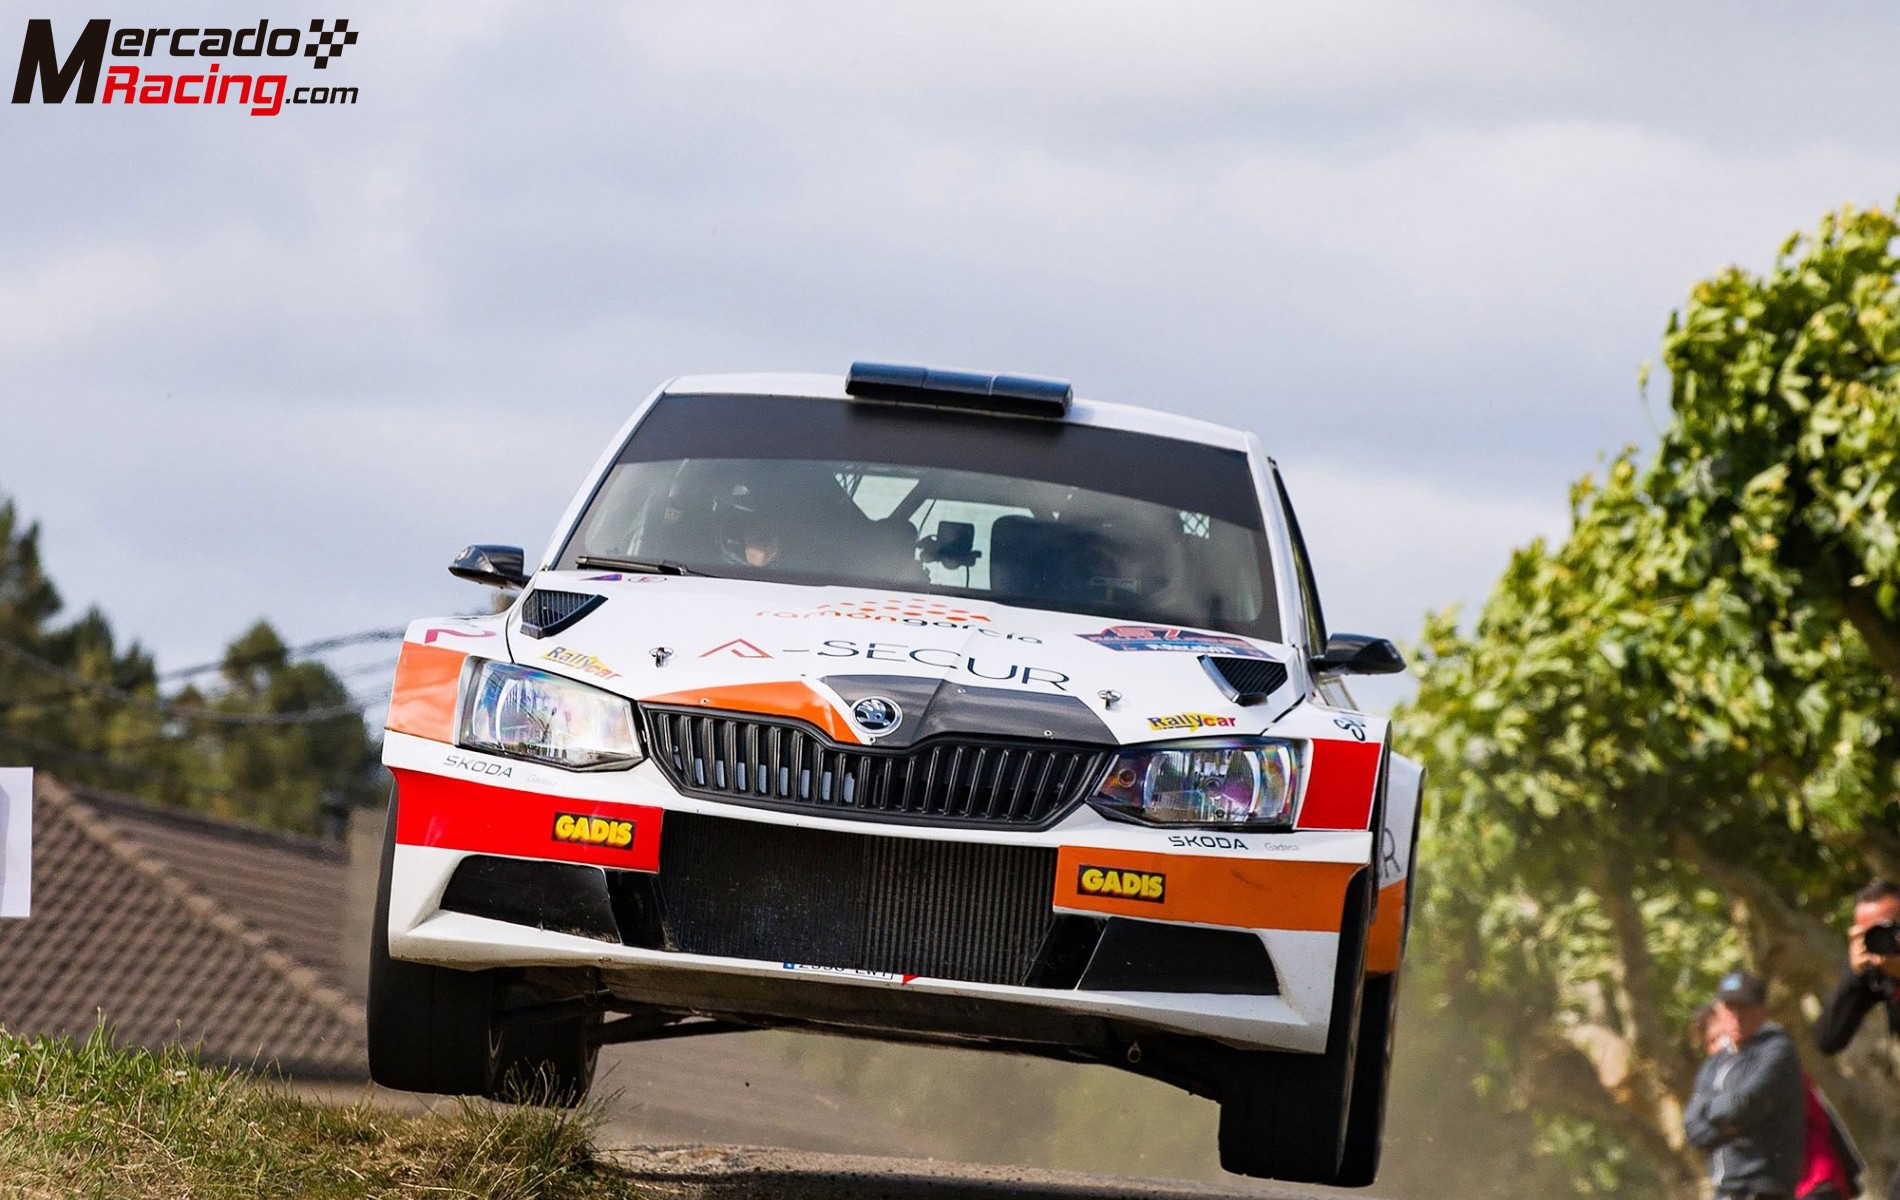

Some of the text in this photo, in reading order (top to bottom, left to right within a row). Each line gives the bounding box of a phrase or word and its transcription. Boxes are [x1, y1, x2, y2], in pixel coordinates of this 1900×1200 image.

[1148, 713, 1236, 732] Rallycar
[555, 814, 632, 847] GADIS
[1081, 867, 1164, 899] GADIS
